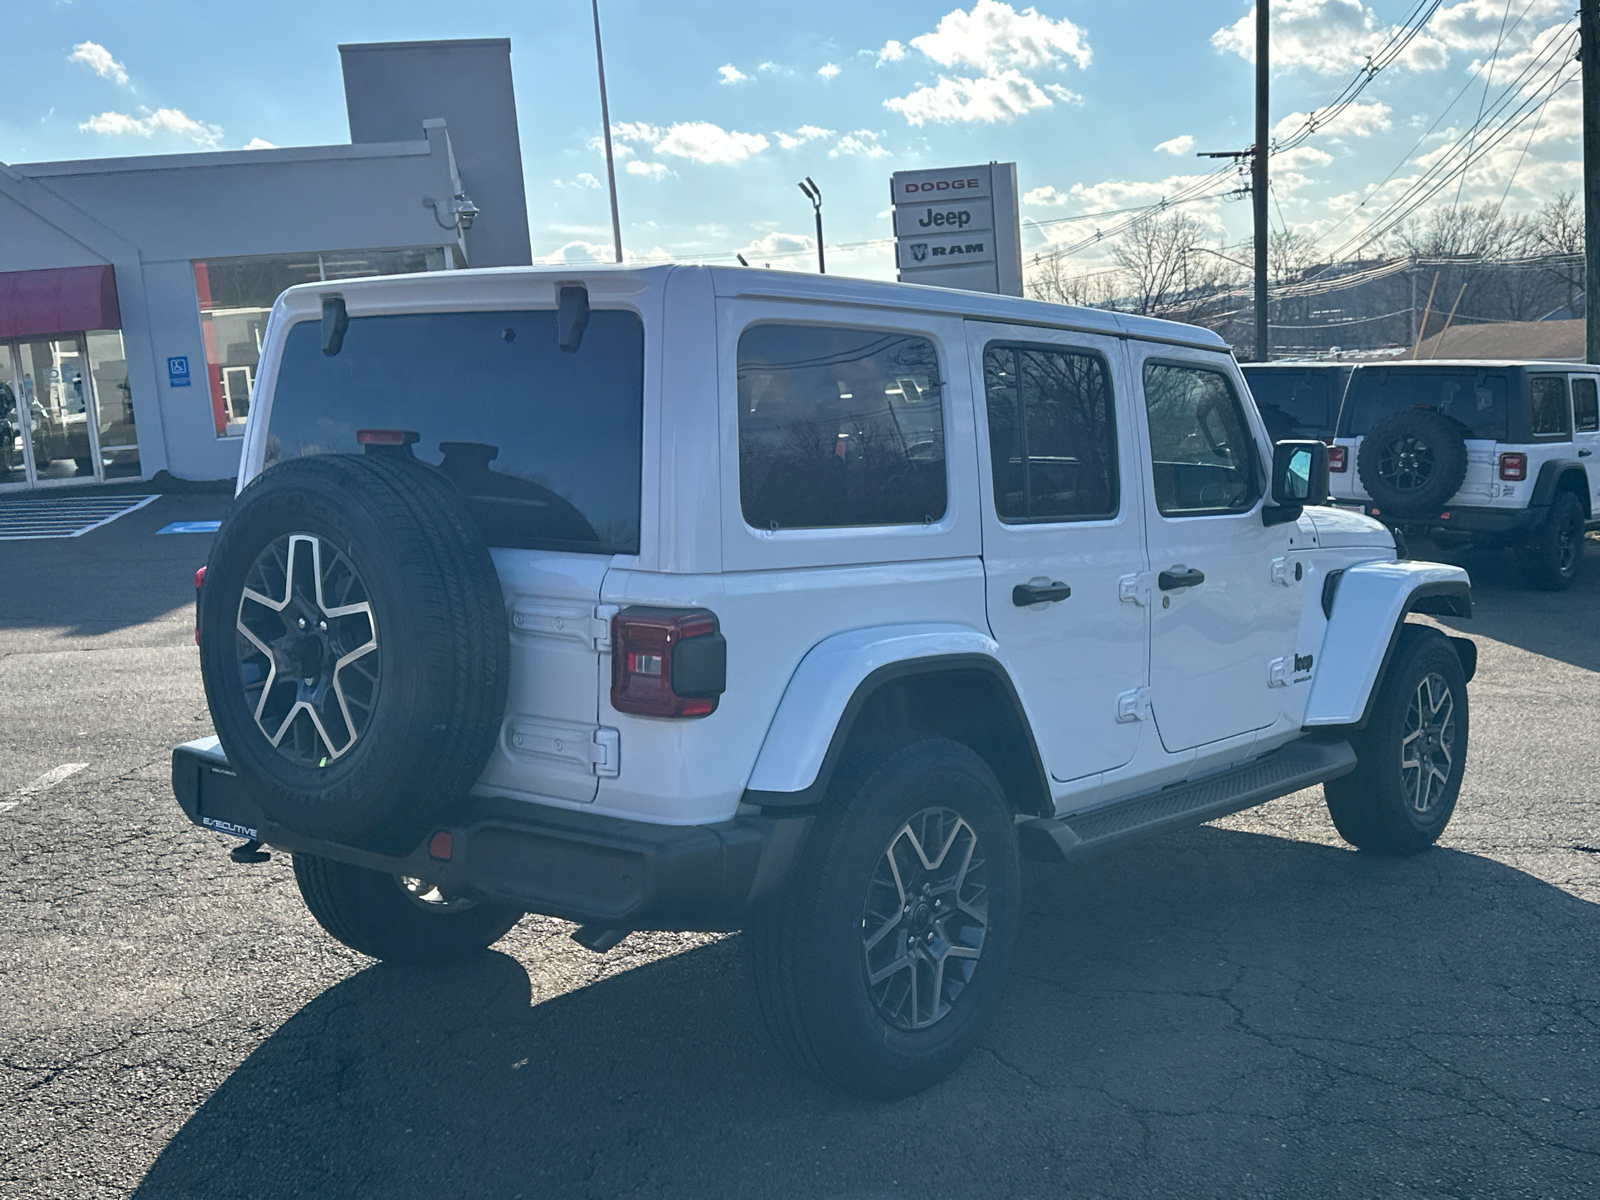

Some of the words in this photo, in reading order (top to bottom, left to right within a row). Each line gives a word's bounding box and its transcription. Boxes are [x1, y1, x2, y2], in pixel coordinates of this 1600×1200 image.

[905, 179, 980, 193] DODGE
[918, 208, 971, 228] Jeep
[931, 243, 984, 256] RAM
[203, 817, 257, 837] EXECUTIVE
